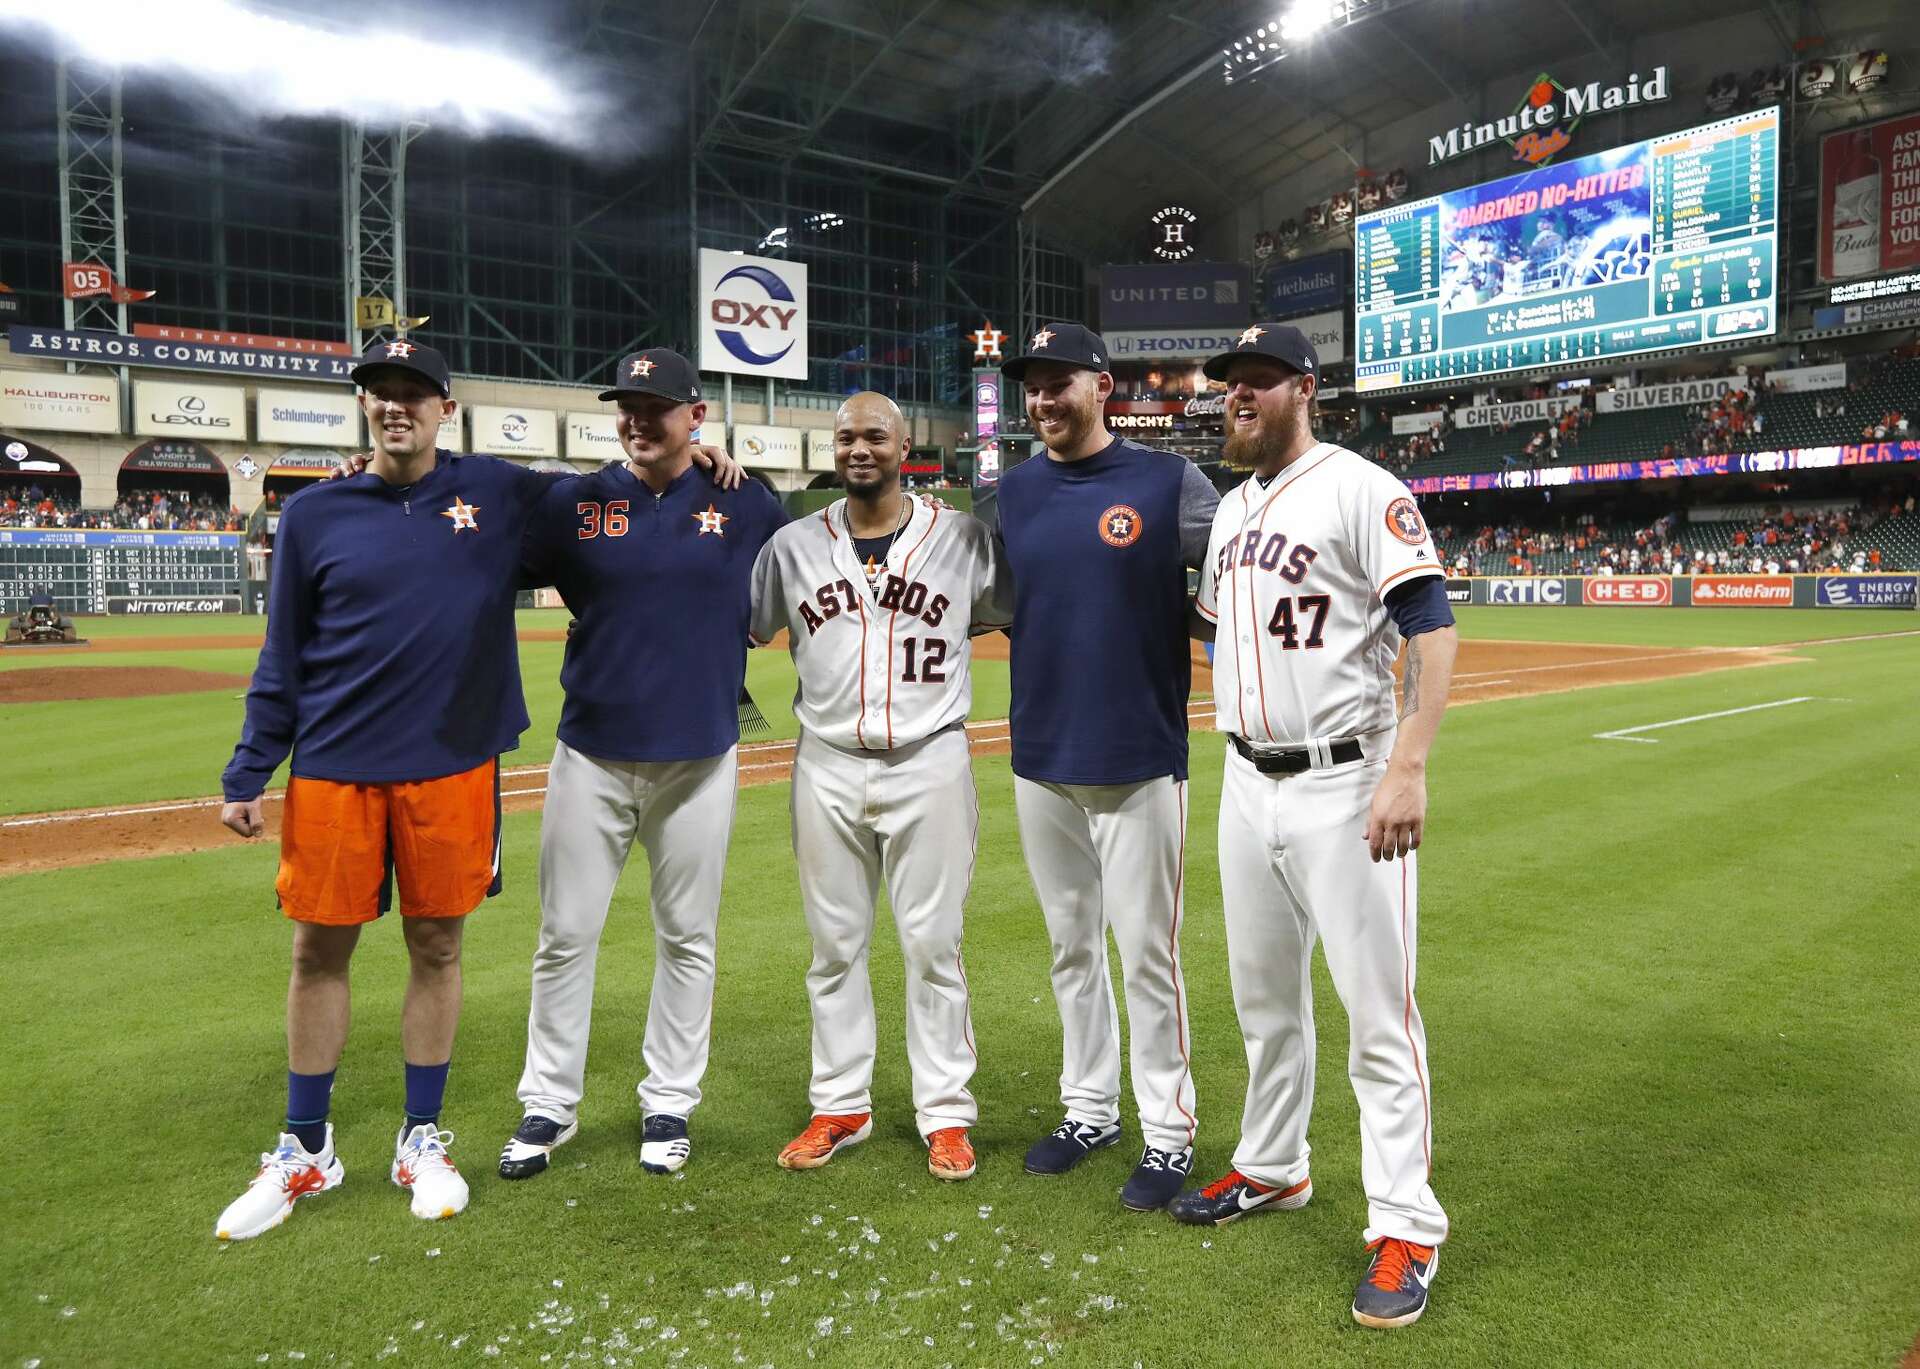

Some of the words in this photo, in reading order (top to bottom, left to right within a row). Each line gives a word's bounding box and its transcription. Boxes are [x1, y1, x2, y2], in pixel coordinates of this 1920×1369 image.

[1427, 103, 1555, 165] Minute
[1562, 66, 1668, 119] Maid
[1541, 164, 1645, 209] NO-HITTER
[1151, 206, 1197, 224] HOUSTON
[1164, 224, 1184, 242] H
[1153, 245, 1194, 260] ASTROS
[73, 271, 101, 289] 05
[1272, 272, 1336, 298] Methodist
[1110, 286, 1208, 302] UNITED
[364, 305, 385, 320] 17
[711, 299, 798, 331] OXY
[159, 329, 255, 345] MINUTE
[276, 341, 333, 352] MAID
[1137, 336, 1238, 351] HONDA
[29, 334, 139, 357] ASTROS
[154, 345, 321, 372] COMMUNITY
[4, 388, 110, 402] HALLIBURTON
[1613, 381, 1730, 409] SILVERADO
[50, 403, 91, 414] YEARS
[272, 407, 346, 427] Schlumberger
[1466, 400, 1568, 425] CHEVROLET
[151, 413, 231, 427] LEXUS
[502, 424, 529, 433] OXY
[280, 457, 323, 467] Crawford
[577, 500, 630, 540] 36
[1213, 530, 1318, 604] STROS
[1489, 579, 1562, 602] RTIC
[1859, 582, 1912, 593] ENERGY
[127, 599, 224, 613] NITTOTIRE.COM
[797, 574, 950, 636] ASTROS
[1268, 594, 1331, 651] 47
[902, 637, 948, 683] 12
